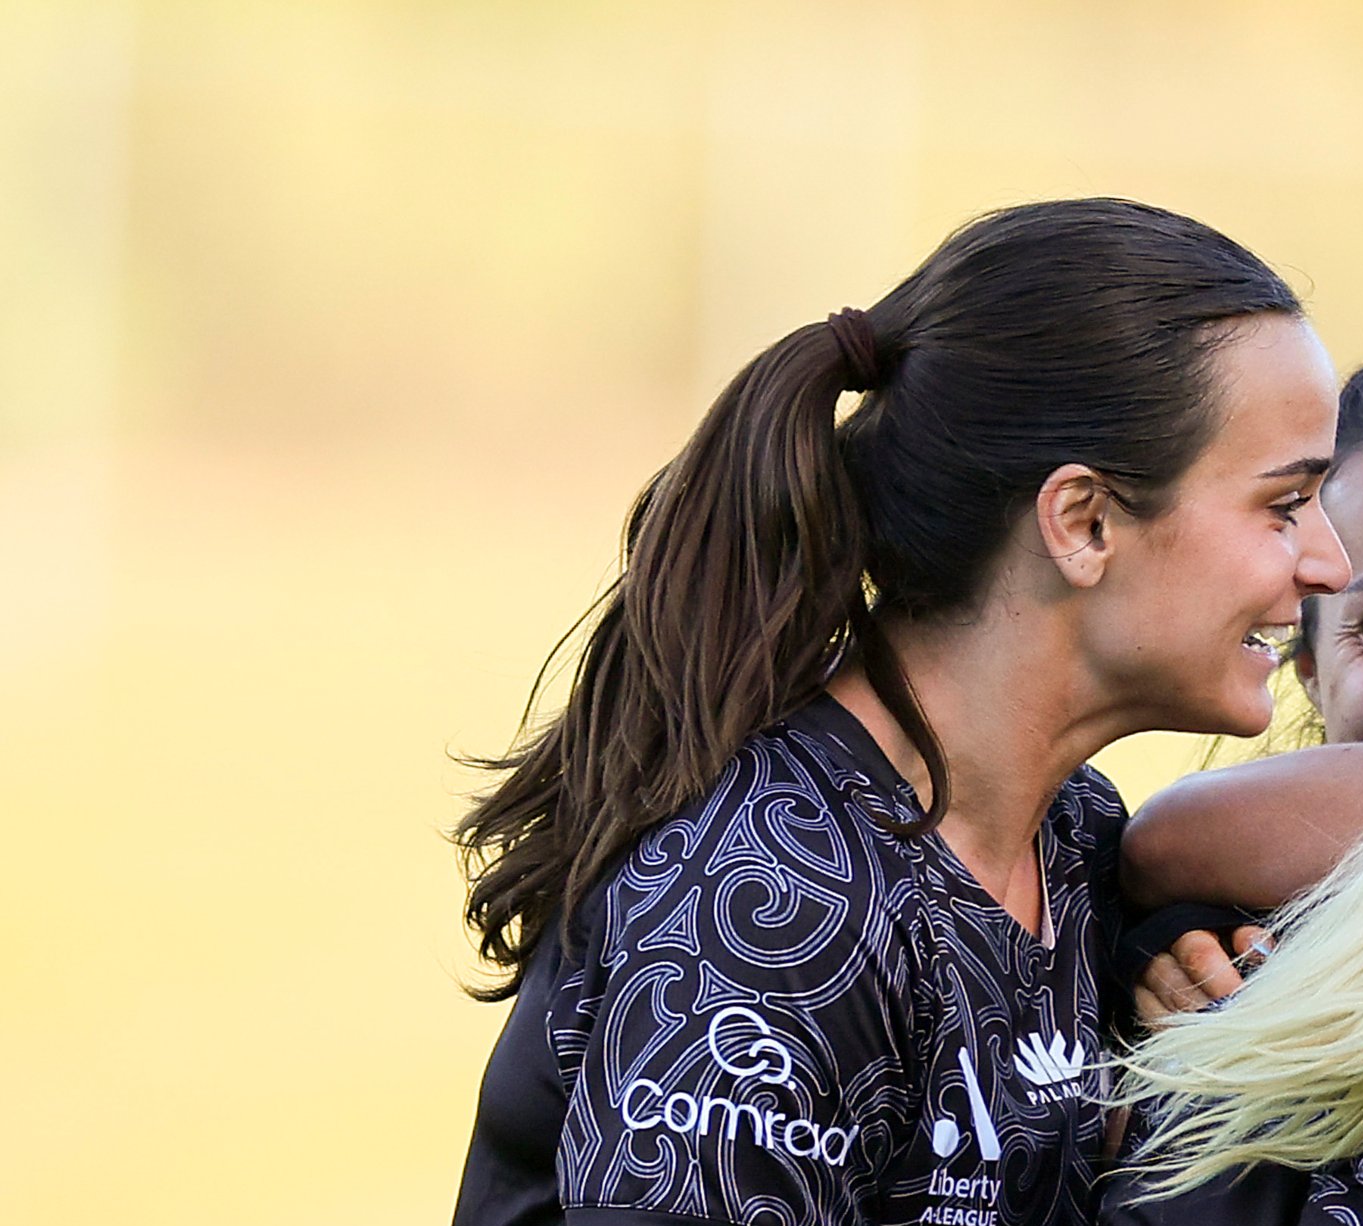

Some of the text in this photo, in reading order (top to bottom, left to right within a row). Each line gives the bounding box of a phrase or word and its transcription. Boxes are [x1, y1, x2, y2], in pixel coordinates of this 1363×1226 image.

[1026, 1081, 1084, 1106] PALAD
[622, 1078, 860, 1167] Comrad
[928, 1168, 1002, 1207] Liberty
